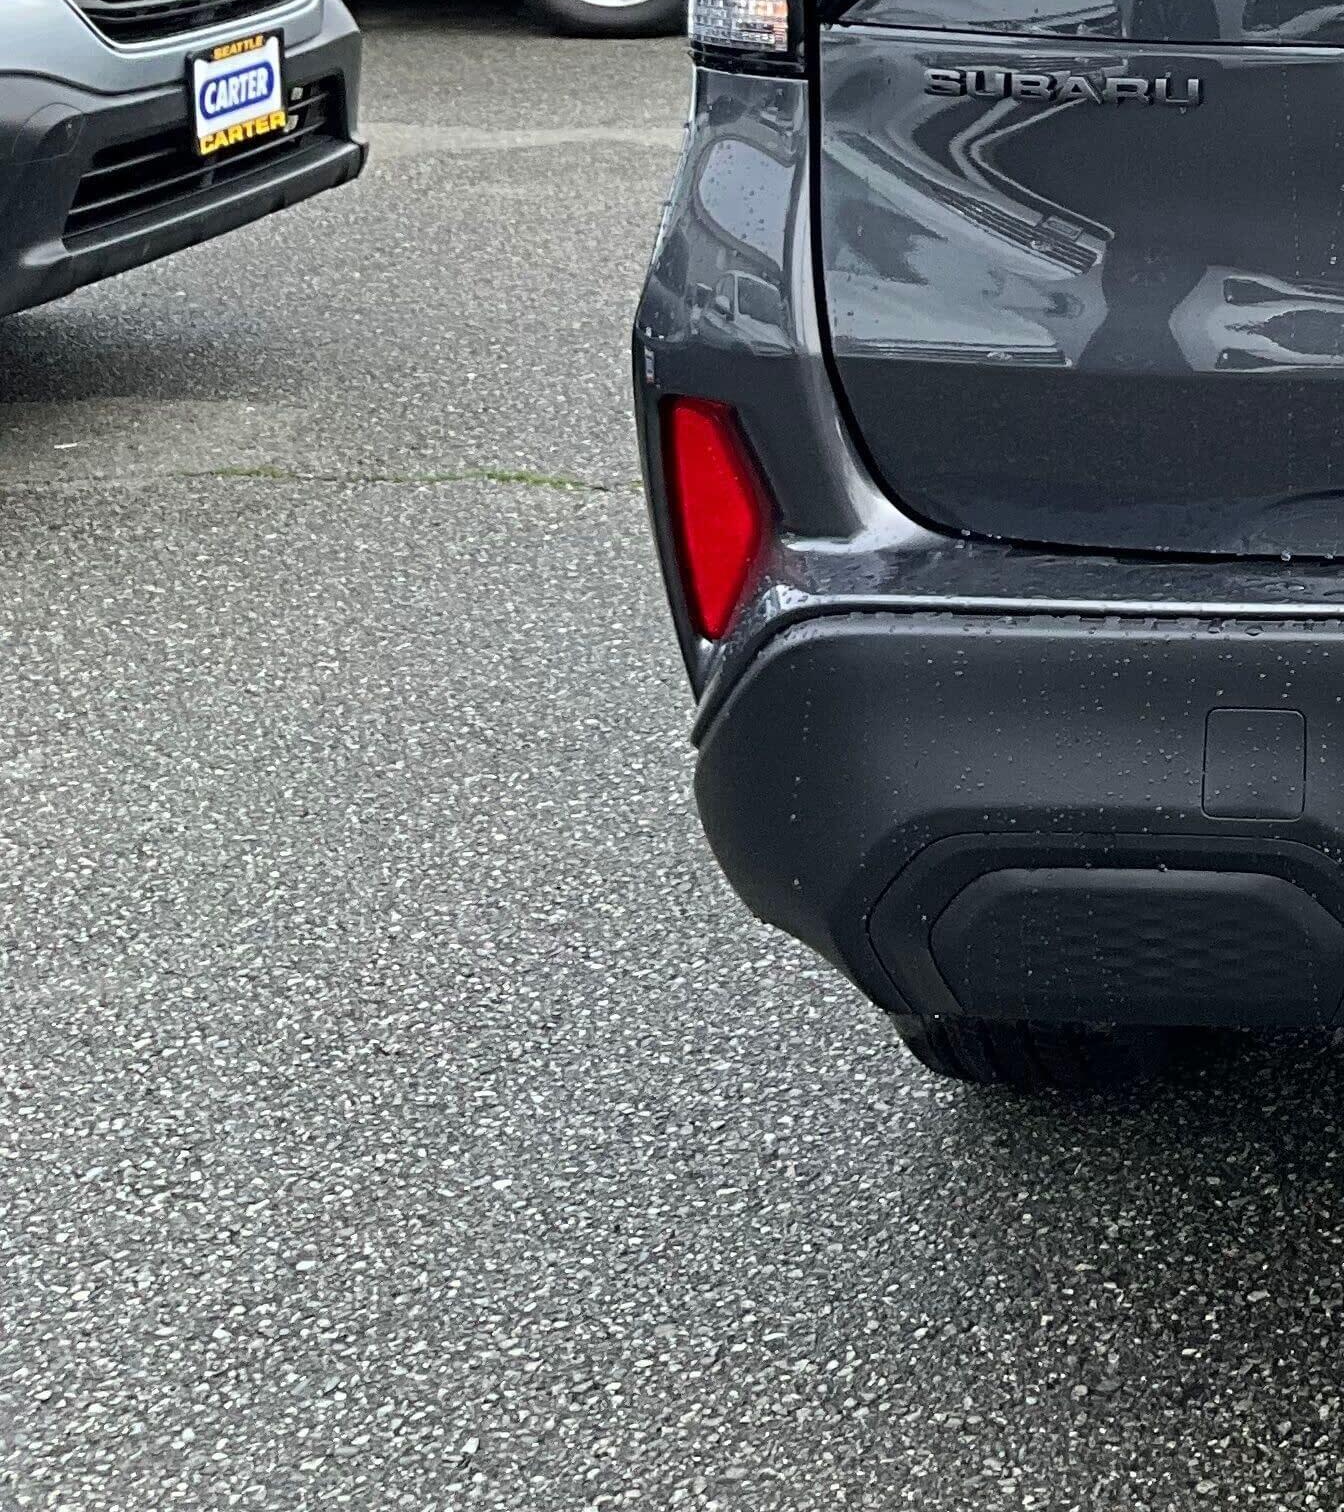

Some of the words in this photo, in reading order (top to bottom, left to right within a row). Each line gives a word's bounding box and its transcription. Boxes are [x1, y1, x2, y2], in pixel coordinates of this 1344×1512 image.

[212, 35, 264, 60] SEATTLE
[204, 67, 269, 114] CARTER
[924, 68, 1200, 104] SUBARU
[200, 110, 286, 155] CARTER
